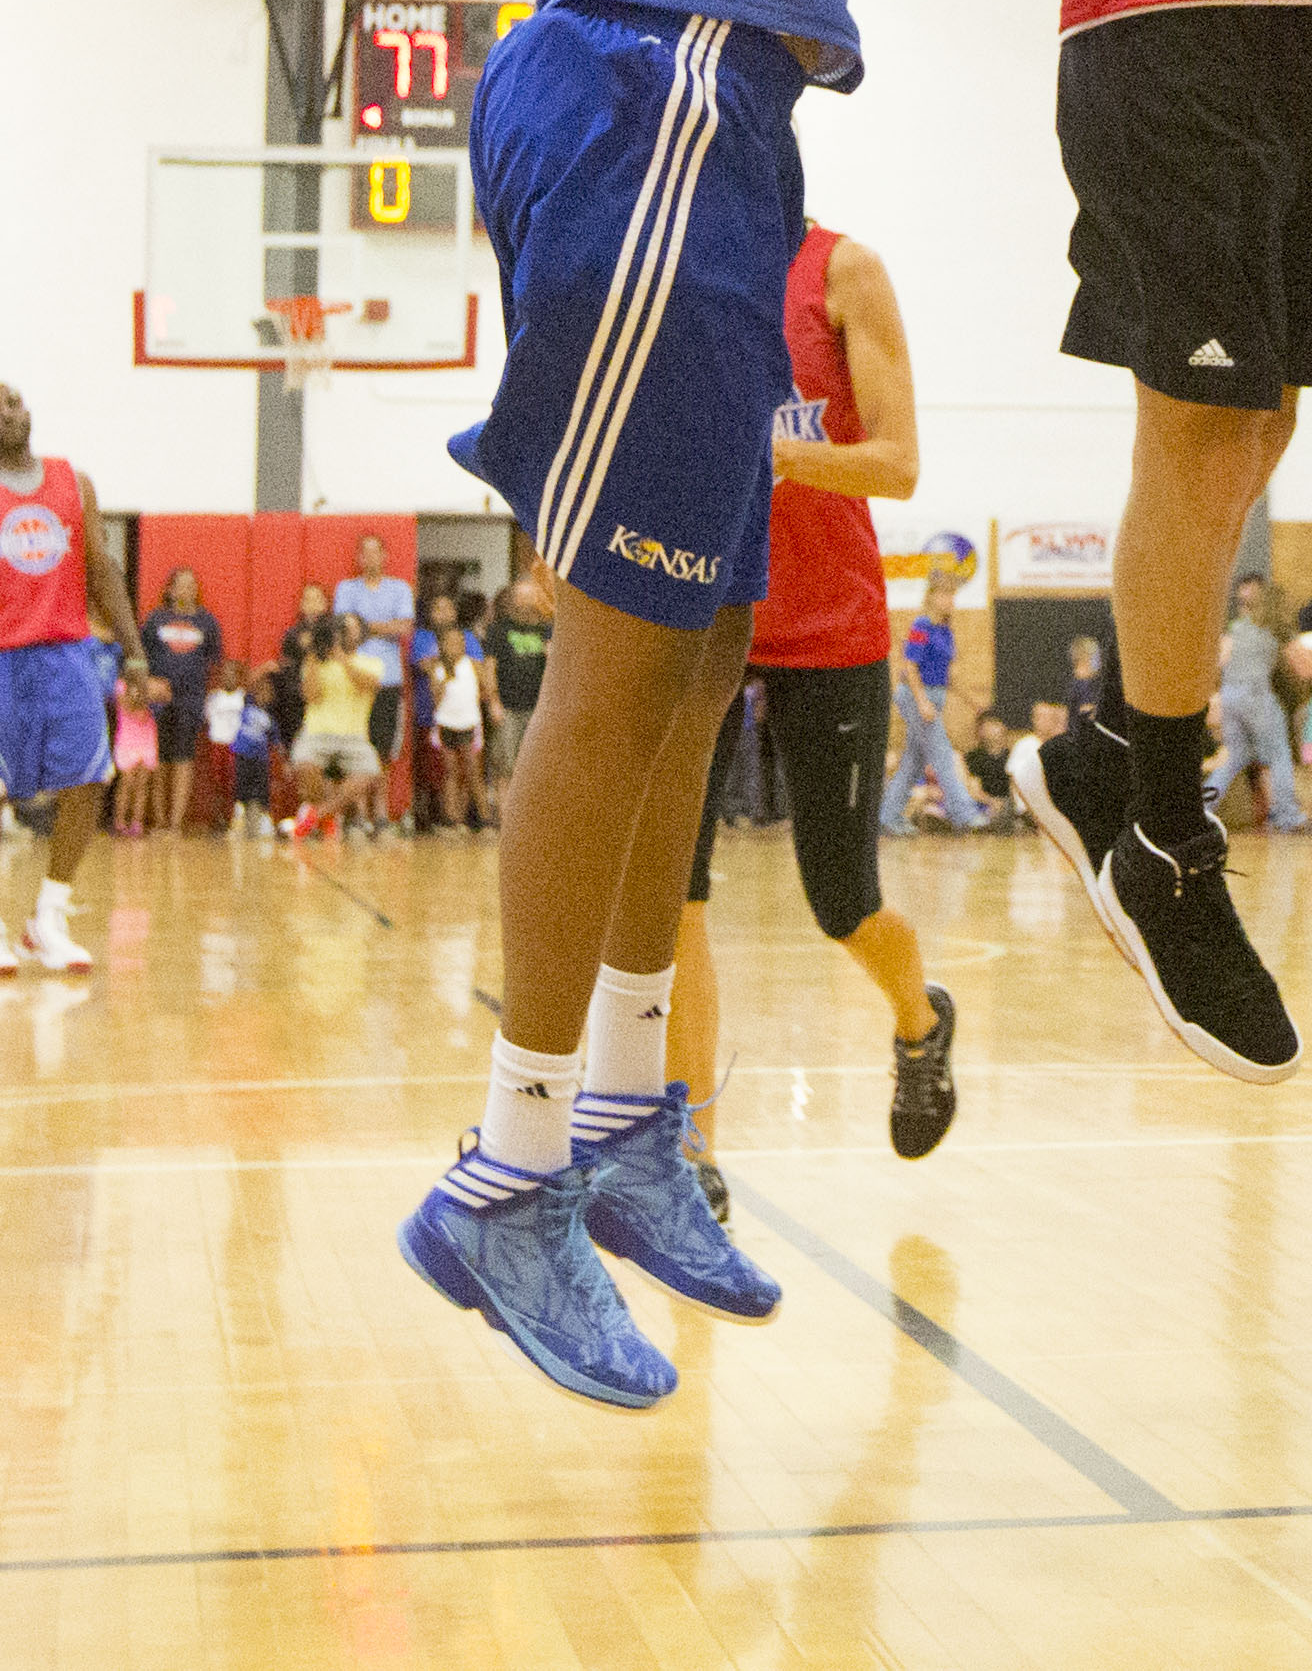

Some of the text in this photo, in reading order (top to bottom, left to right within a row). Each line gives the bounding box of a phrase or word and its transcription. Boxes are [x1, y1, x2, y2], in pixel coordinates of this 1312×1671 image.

[362, 3, 447, 32] HOME
[373, 30, 449, 100] 77
[368, 156, 411, 223] 0
[607, 524, 721, 584] KNSAS
